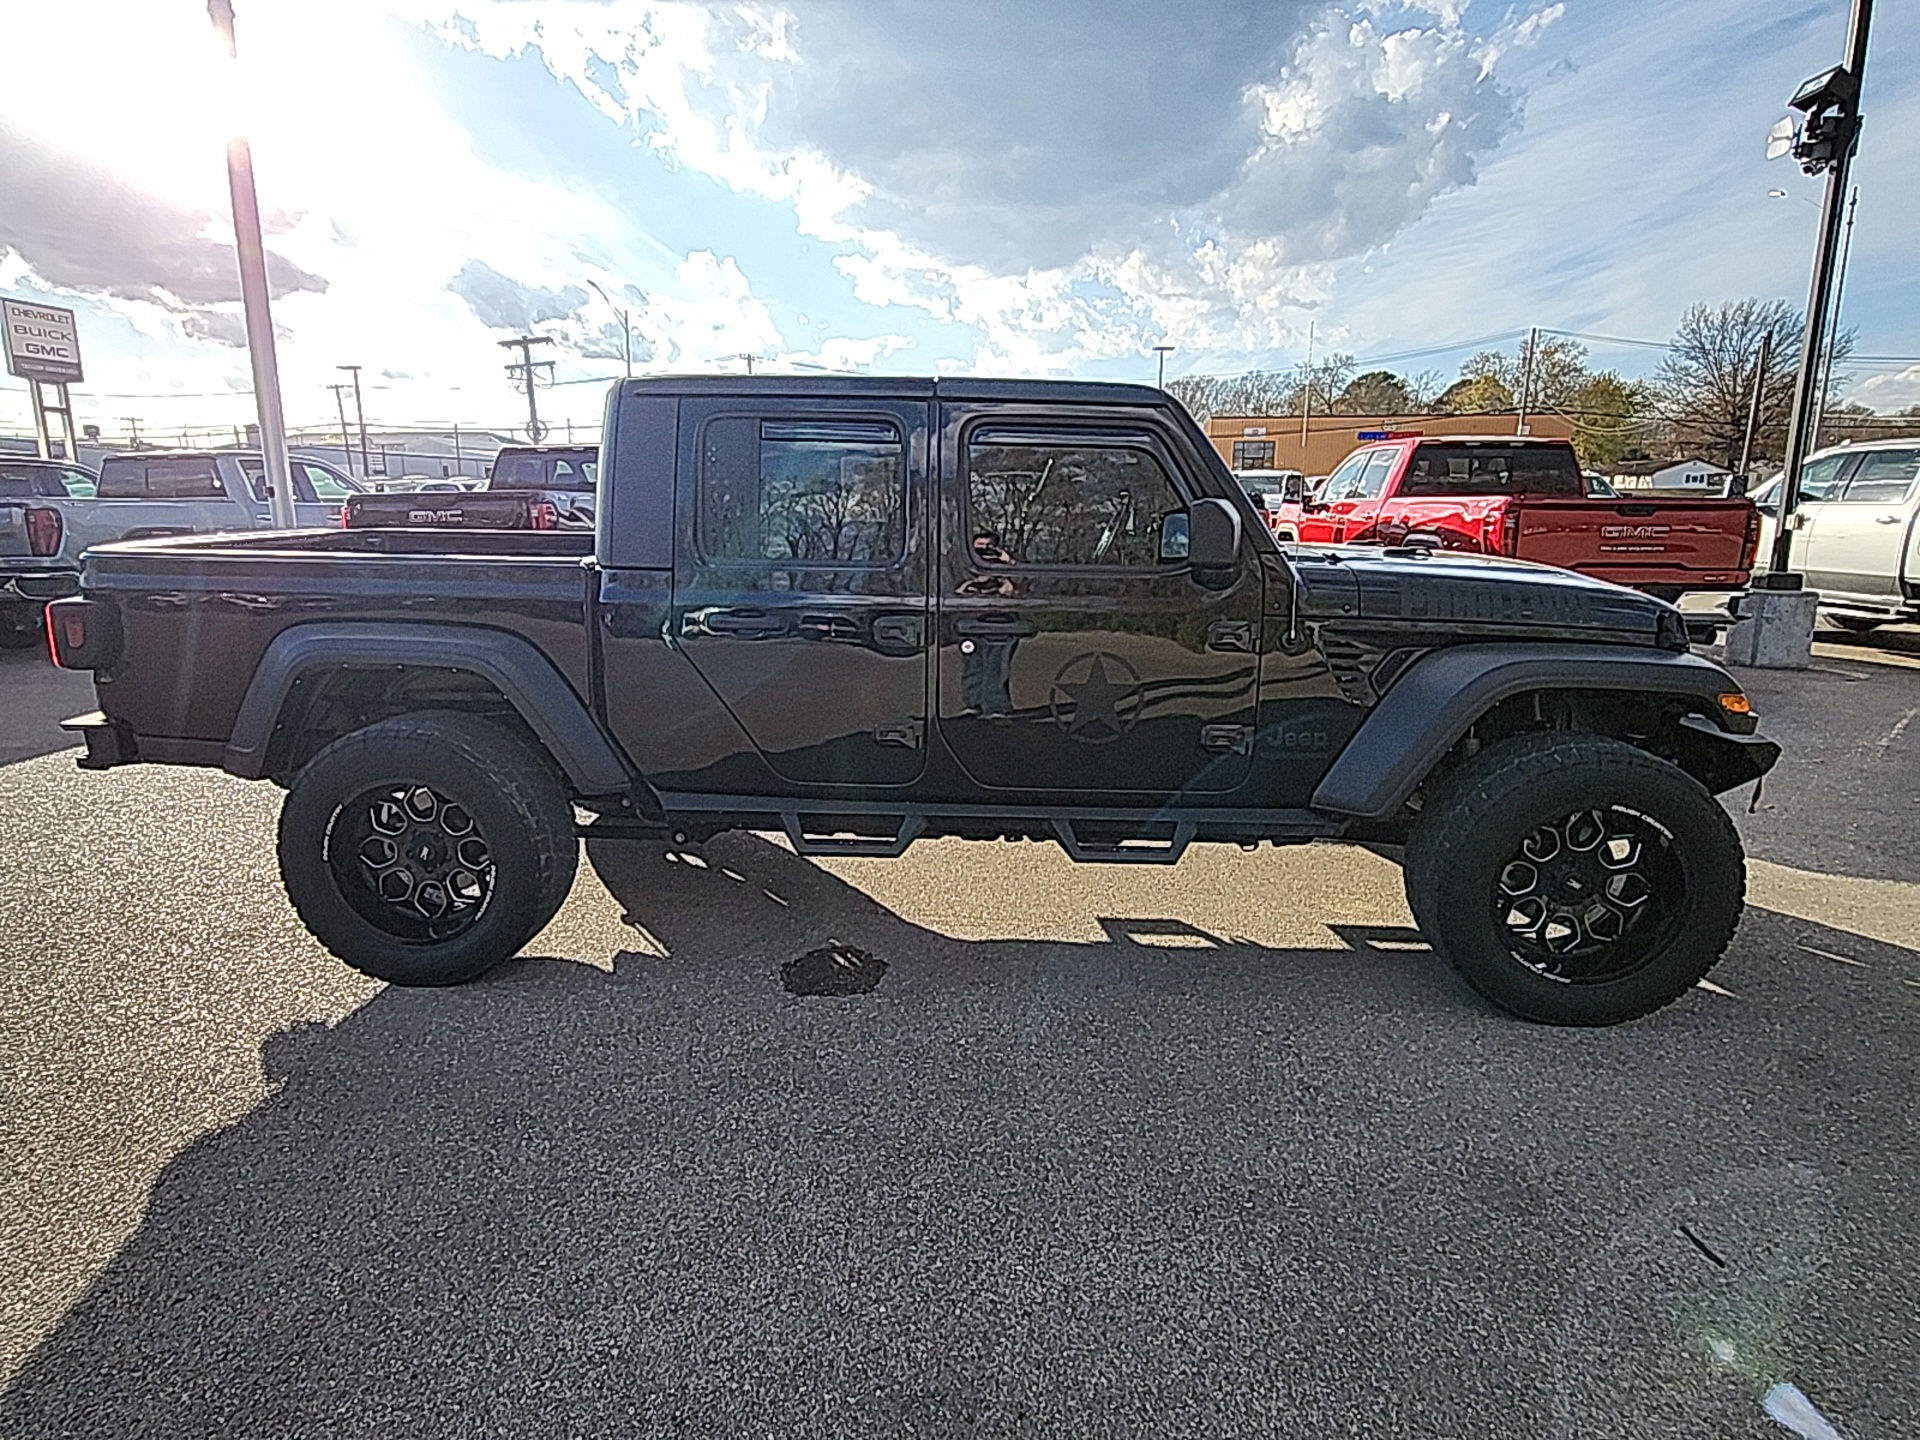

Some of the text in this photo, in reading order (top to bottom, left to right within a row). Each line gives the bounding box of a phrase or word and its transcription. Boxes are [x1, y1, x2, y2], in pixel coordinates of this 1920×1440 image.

[11, 307, 70, 325] CHEVROLET
[13, 325, 74, 342] BUICK
[25, 343, 70, 358] GMC
[408, 510, 463, 523] GMC
[1600, 525, 1671, 539] GMC
[1266, 726, 1328, 752] Jeep
